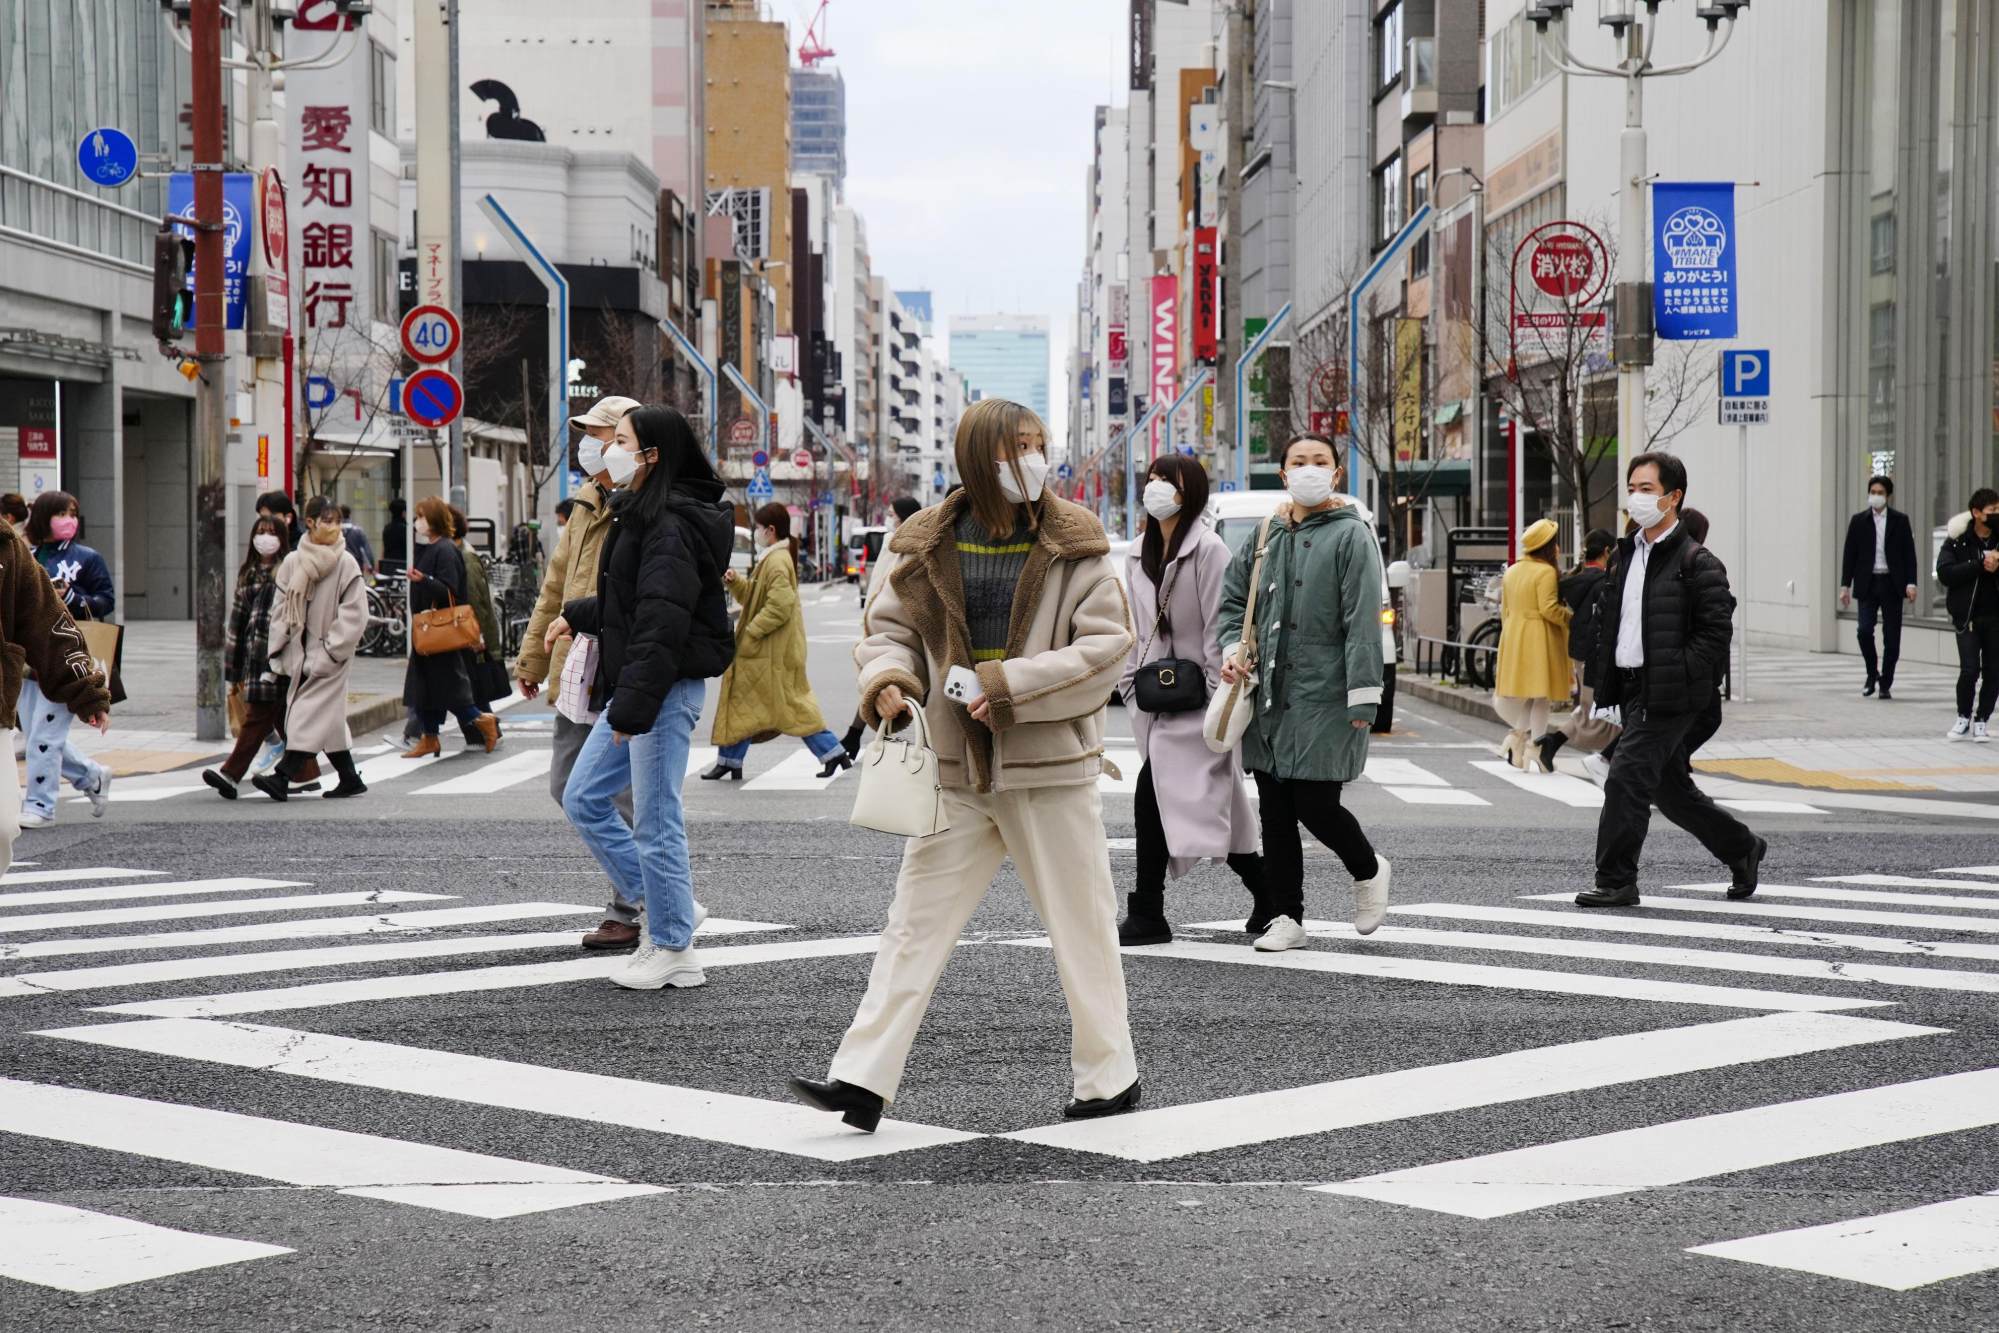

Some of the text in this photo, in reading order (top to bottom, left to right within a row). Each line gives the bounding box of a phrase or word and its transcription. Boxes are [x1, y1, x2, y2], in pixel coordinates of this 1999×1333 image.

[301, 105, 353, 328] 愛知銀行
[1673, 248, 1717, 257] #MAKE
[1675, 257, 1715, 266] ITBLUE
[426, 243, 443, 305] マネープラ
[1535, 253, 1590, 279] 消火栓
[1663, 270, 1728, 283] ありがとう!
[415, 322, 447, 348] 40
[1735, 354, 1762, 393] P
